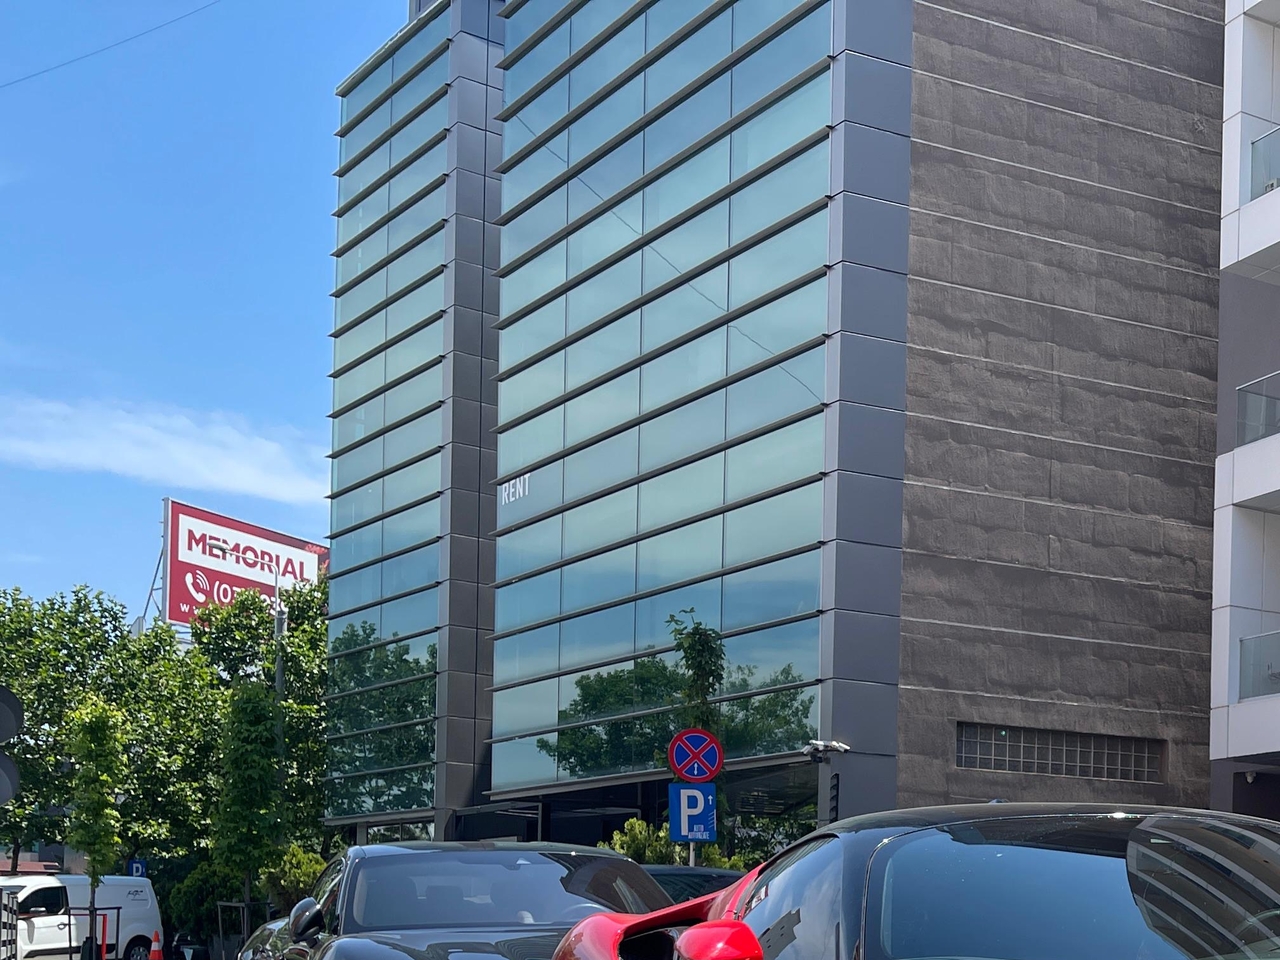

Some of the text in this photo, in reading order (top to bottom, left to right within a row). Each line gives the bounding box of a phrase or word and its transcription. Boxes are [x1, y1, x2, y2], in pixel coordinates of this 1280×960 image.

[502, 473, 530, 505] RENT
[187, 528, 310, 581] MEMORIAL
[680, 789, 705, 836] P
